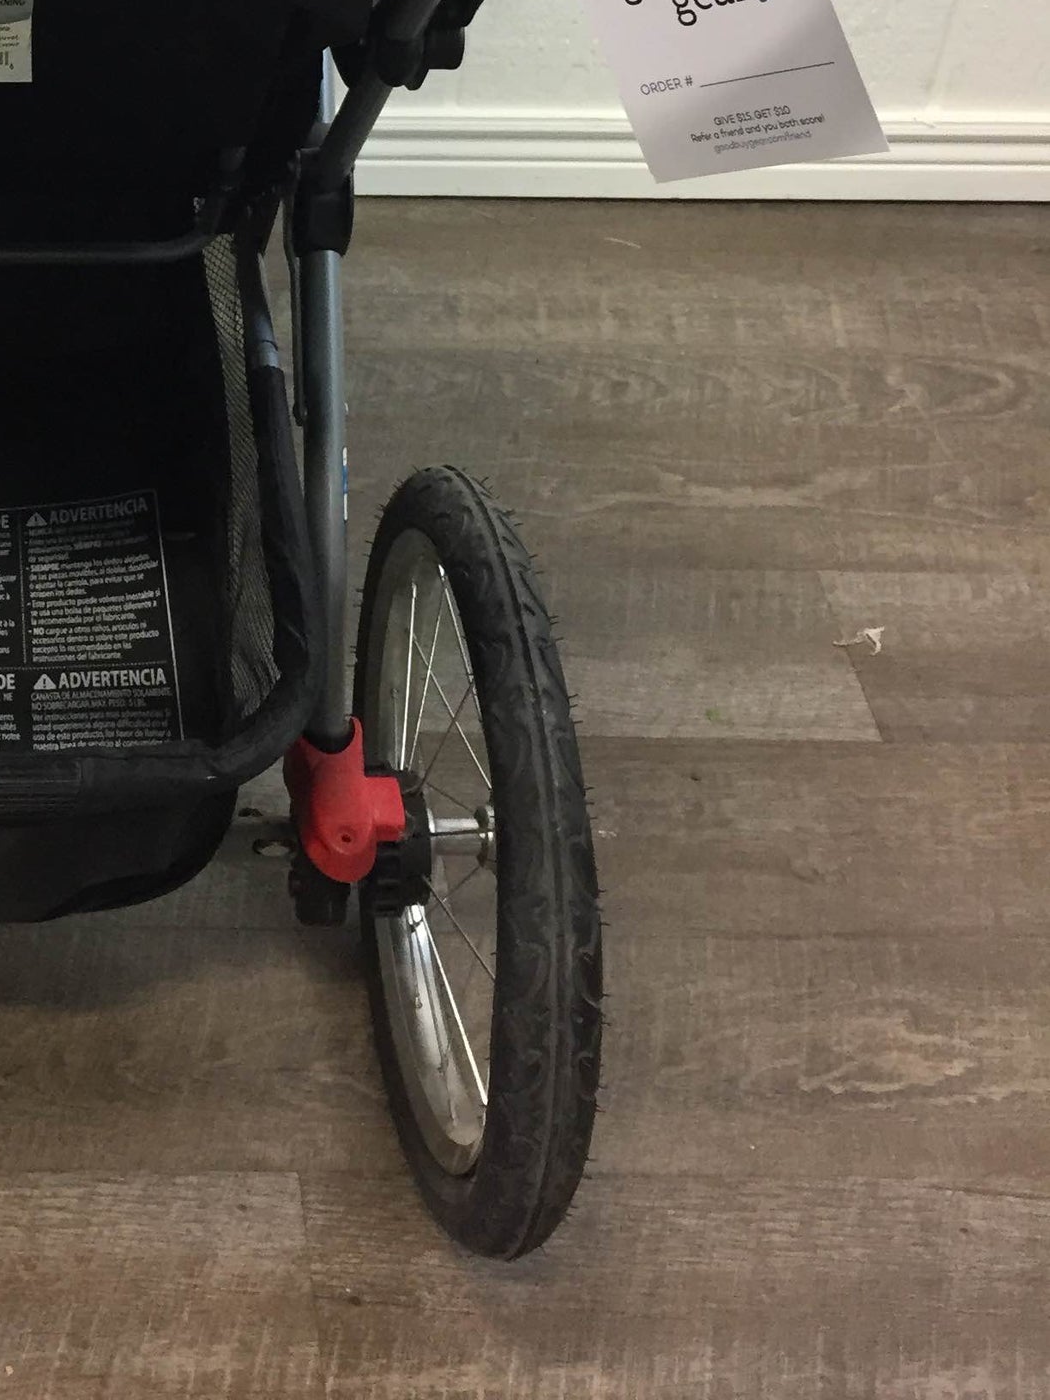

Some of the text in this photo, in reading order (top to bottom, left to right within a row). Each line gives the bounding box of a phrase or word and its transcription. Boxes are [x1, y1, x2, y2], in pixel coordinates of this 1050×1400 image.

[640, 75, 693, 96] ORDER #
[713, 116, 735, 126] GIVE
[753, 108, 772, 120] GET
[690, 133, 712, 143] Refer
[720, 127, 744, 138] friend
[745, 124, 761, 134] and
[762, 123, 778, 134] you
[780, 118, 799, 129] both
[49, 496, 149, 525] ADVERTENCIA
[58, 667, 167, 690] ADVERTENCIA
